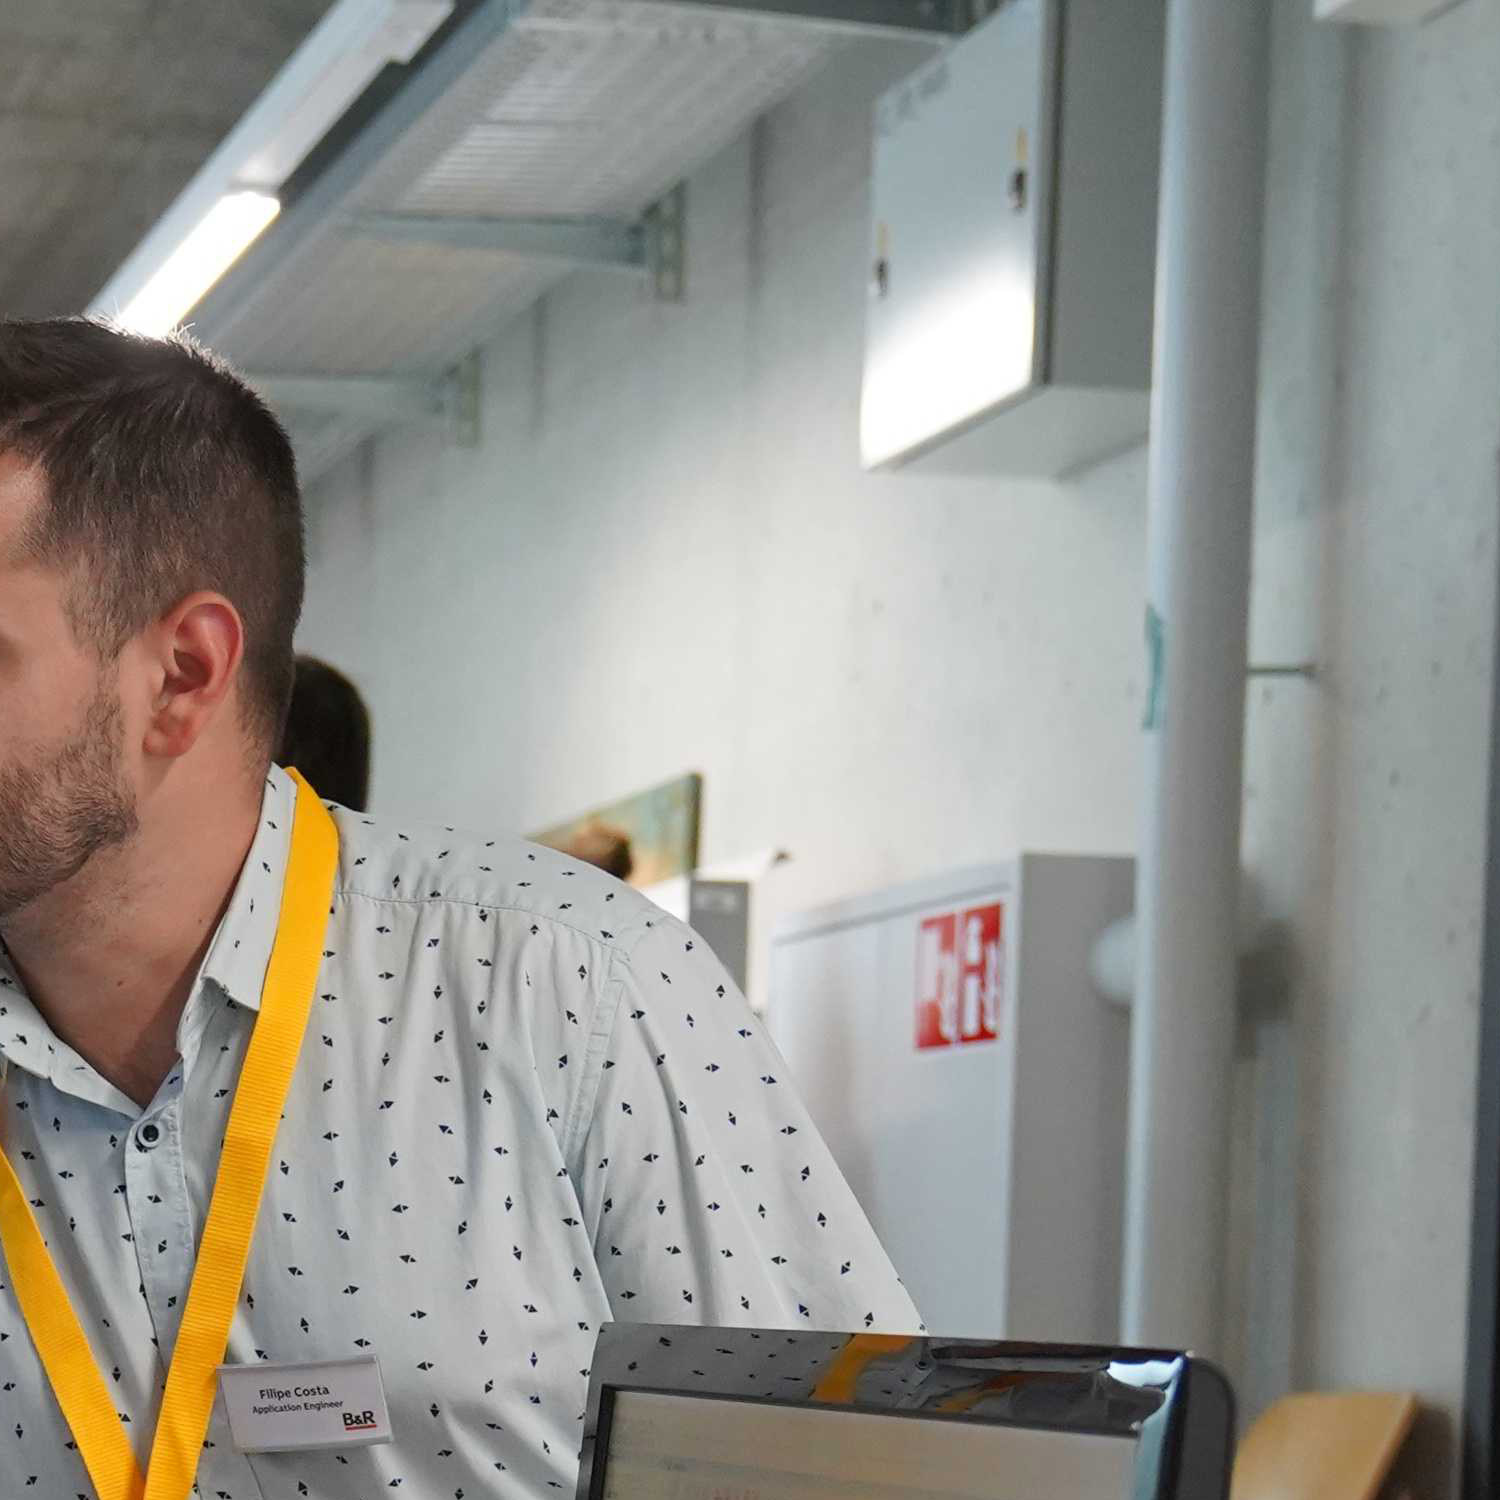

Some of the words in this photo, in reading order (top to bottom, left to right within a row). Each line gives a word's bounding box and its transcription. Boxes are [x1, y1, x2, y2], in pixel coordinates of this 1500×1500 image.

[259, 1388, 291, 1401] Filipe
[294, 1385, 330, 1397] Costa
[252, 1403, 302, 1414] Application
[304, 1401, 343, 1411] Engineer
[343, 1410, 375, 1426] B&R
